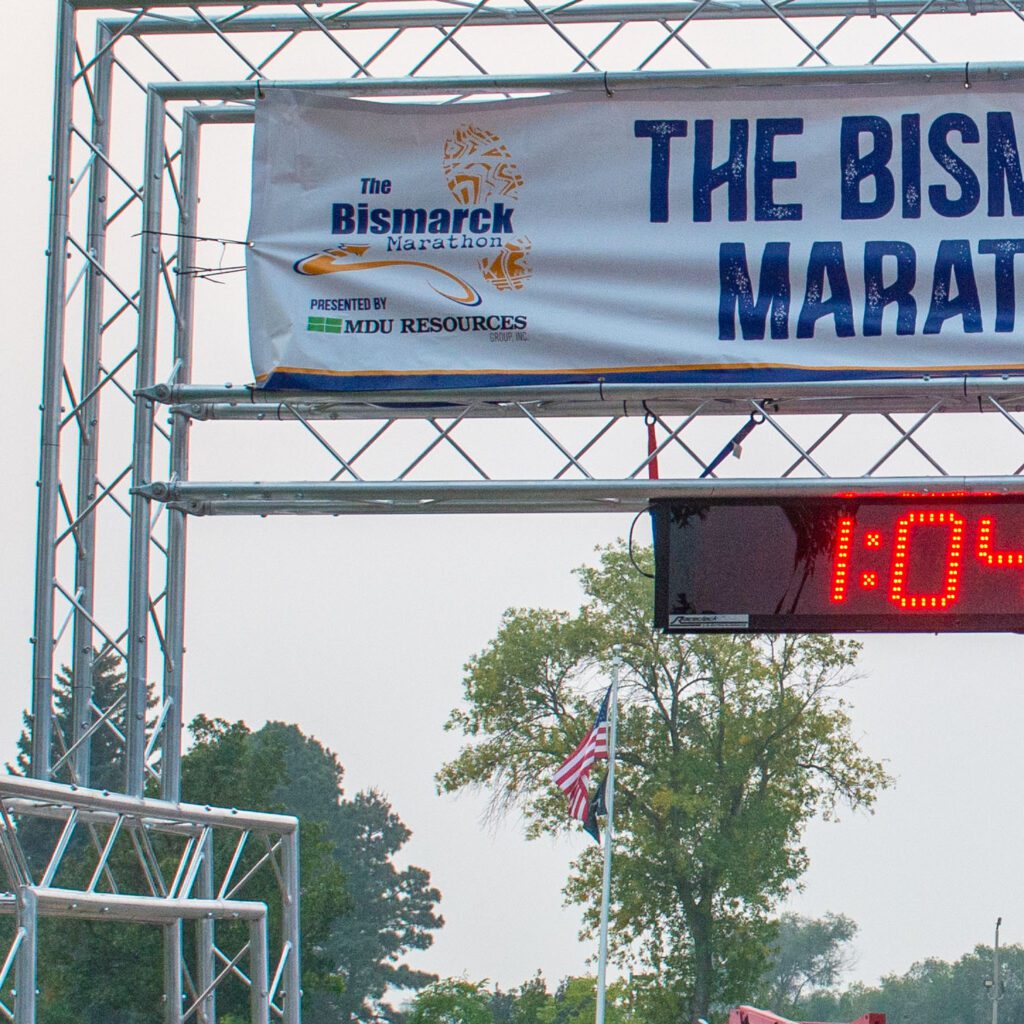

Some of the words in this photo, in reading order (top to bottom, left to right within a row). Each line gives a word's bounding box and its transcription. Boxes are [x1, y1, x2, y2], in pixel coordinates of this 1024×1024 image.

[634, 117, 805, 222] THE
[360, 177, 392, 195] The
[331, 203, 515, 235] Bismarck
[386, 234, 503, 252] Marathon
[310, 298, 371, 311] PRESENTED
[373, 297, 387, 310] BY
[343, 319, 394, 335] MDU
[400, 315, 528, 333] RESOURCES
